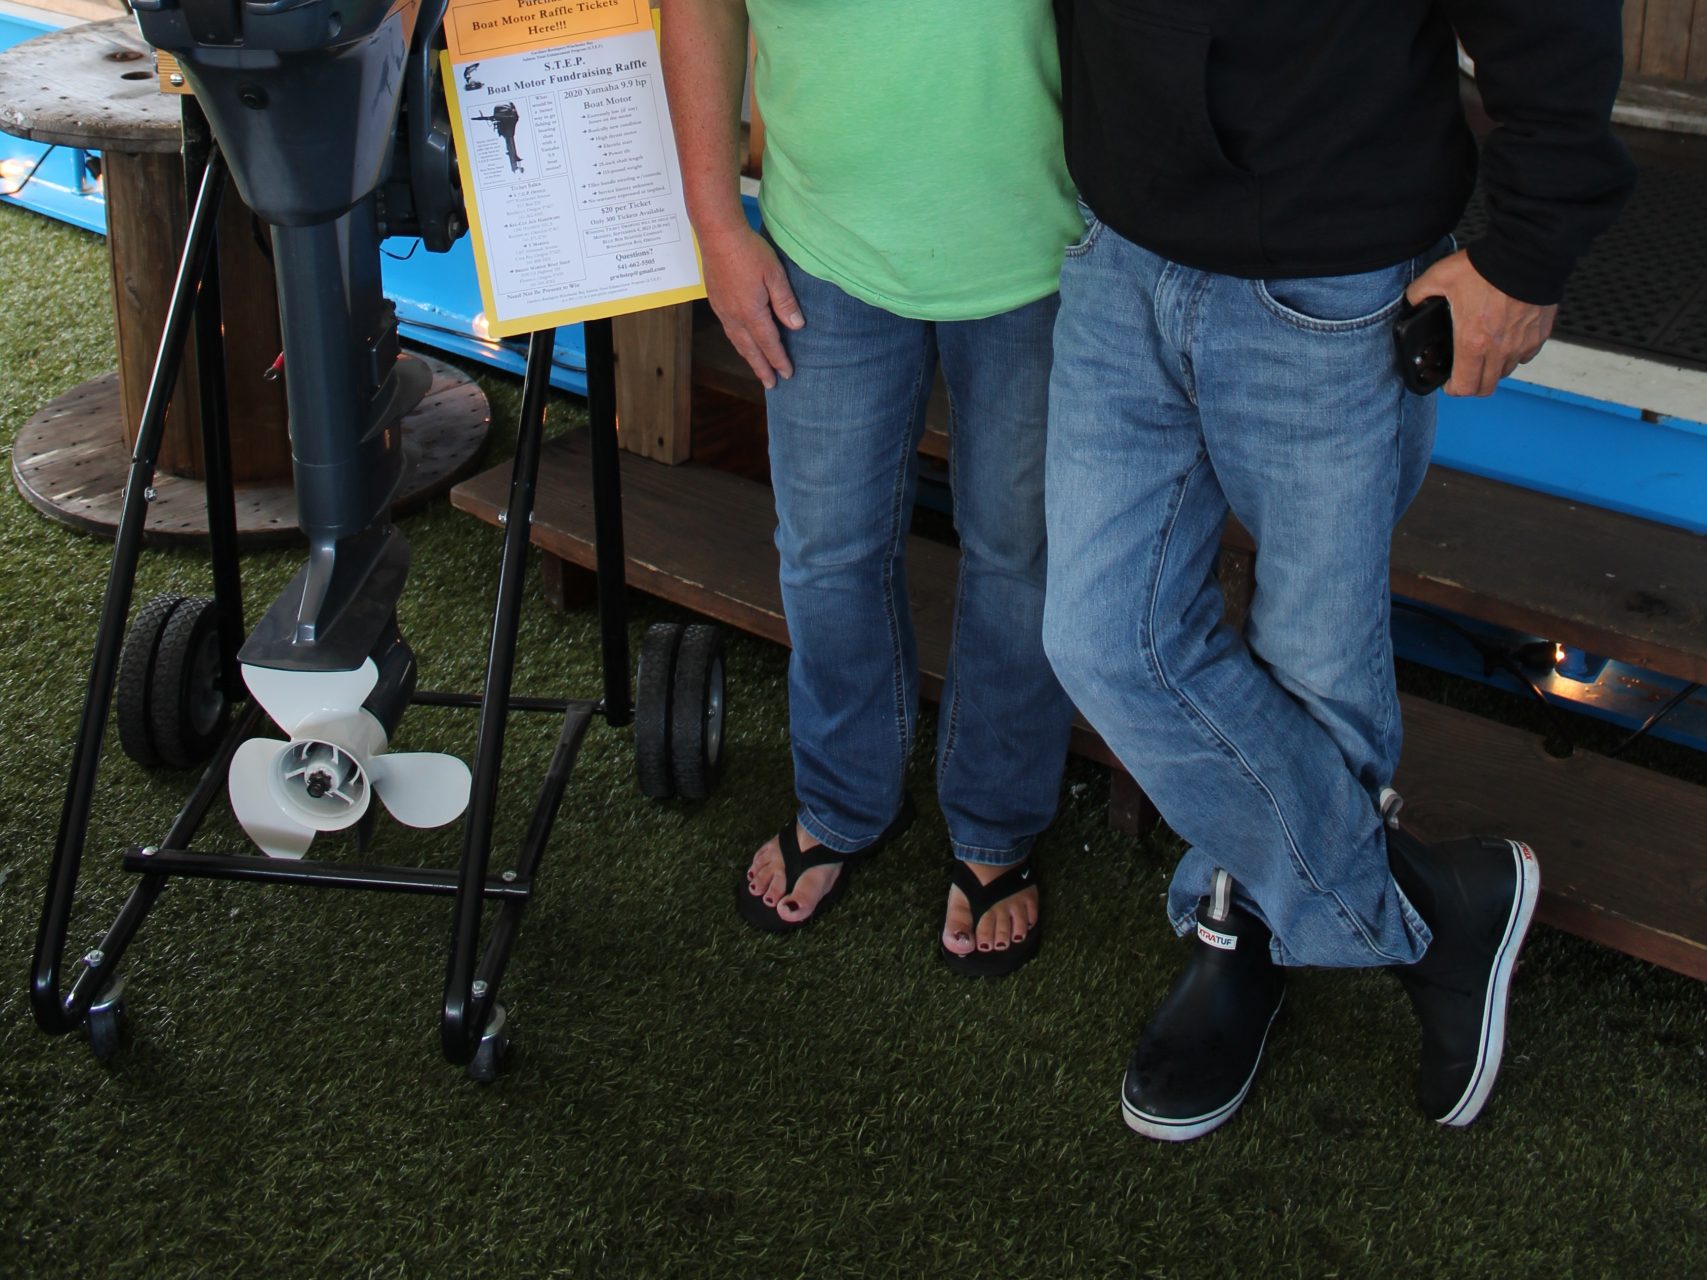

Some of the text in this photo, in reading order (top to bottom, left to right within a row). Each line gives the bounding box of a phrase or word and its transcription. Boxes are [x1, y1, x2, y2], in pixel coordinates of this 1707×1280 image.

[472, 19, 498, 31] Boat
[502, 14, 535, 27] Motor
[539, 6, 573, 19] Raffle
[528, 21, 567, 35] Here!!!
[544, 57, 586, 71] S.T.E.P.
[487, 60, 647, 96] Boat Motor Fundraising Raffle
[563, 77, 647, 99] 2020 Yamaha 9.9 hp
[582, 94, 632, 109] Boat Motor
[627, 198, 651, 209] Ticket
[614, 247, 654, 262] Questions?
